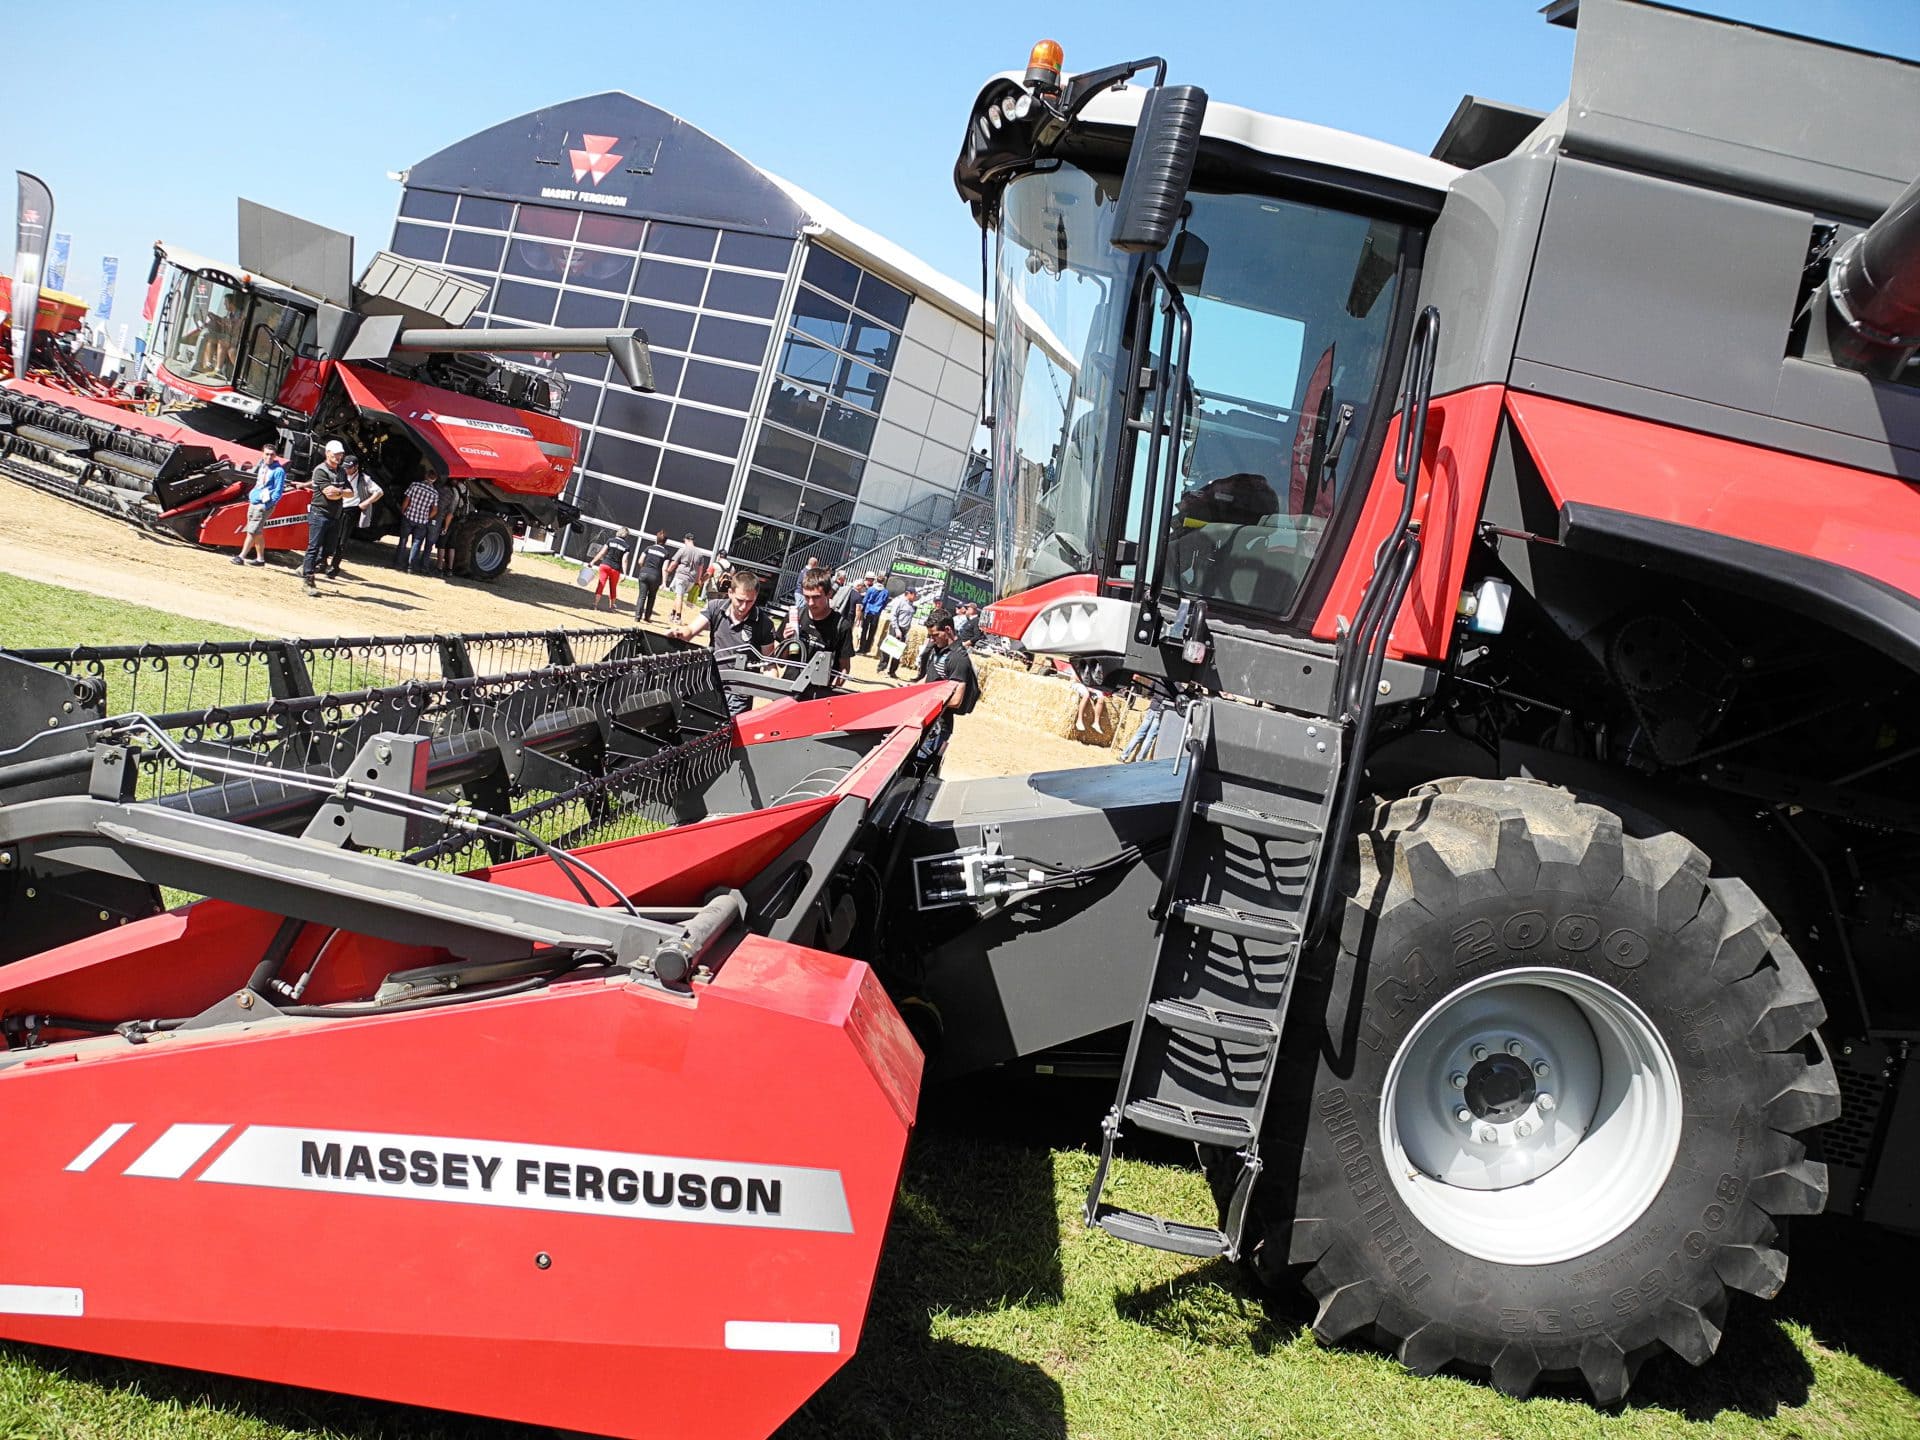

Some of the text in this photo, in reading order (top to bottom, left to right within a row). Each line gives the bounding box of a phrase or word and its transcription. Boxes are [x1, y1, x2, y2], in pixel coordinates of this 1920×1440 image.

[541, 187, 627, 207] MASSEY FERGUSON
[1452, 910, 1651, 969] 2000
[301, 1140, 782, 1216] MASSEY FERGUSON
[1319, 1086, 1432, 1304] TRELLEBORG
